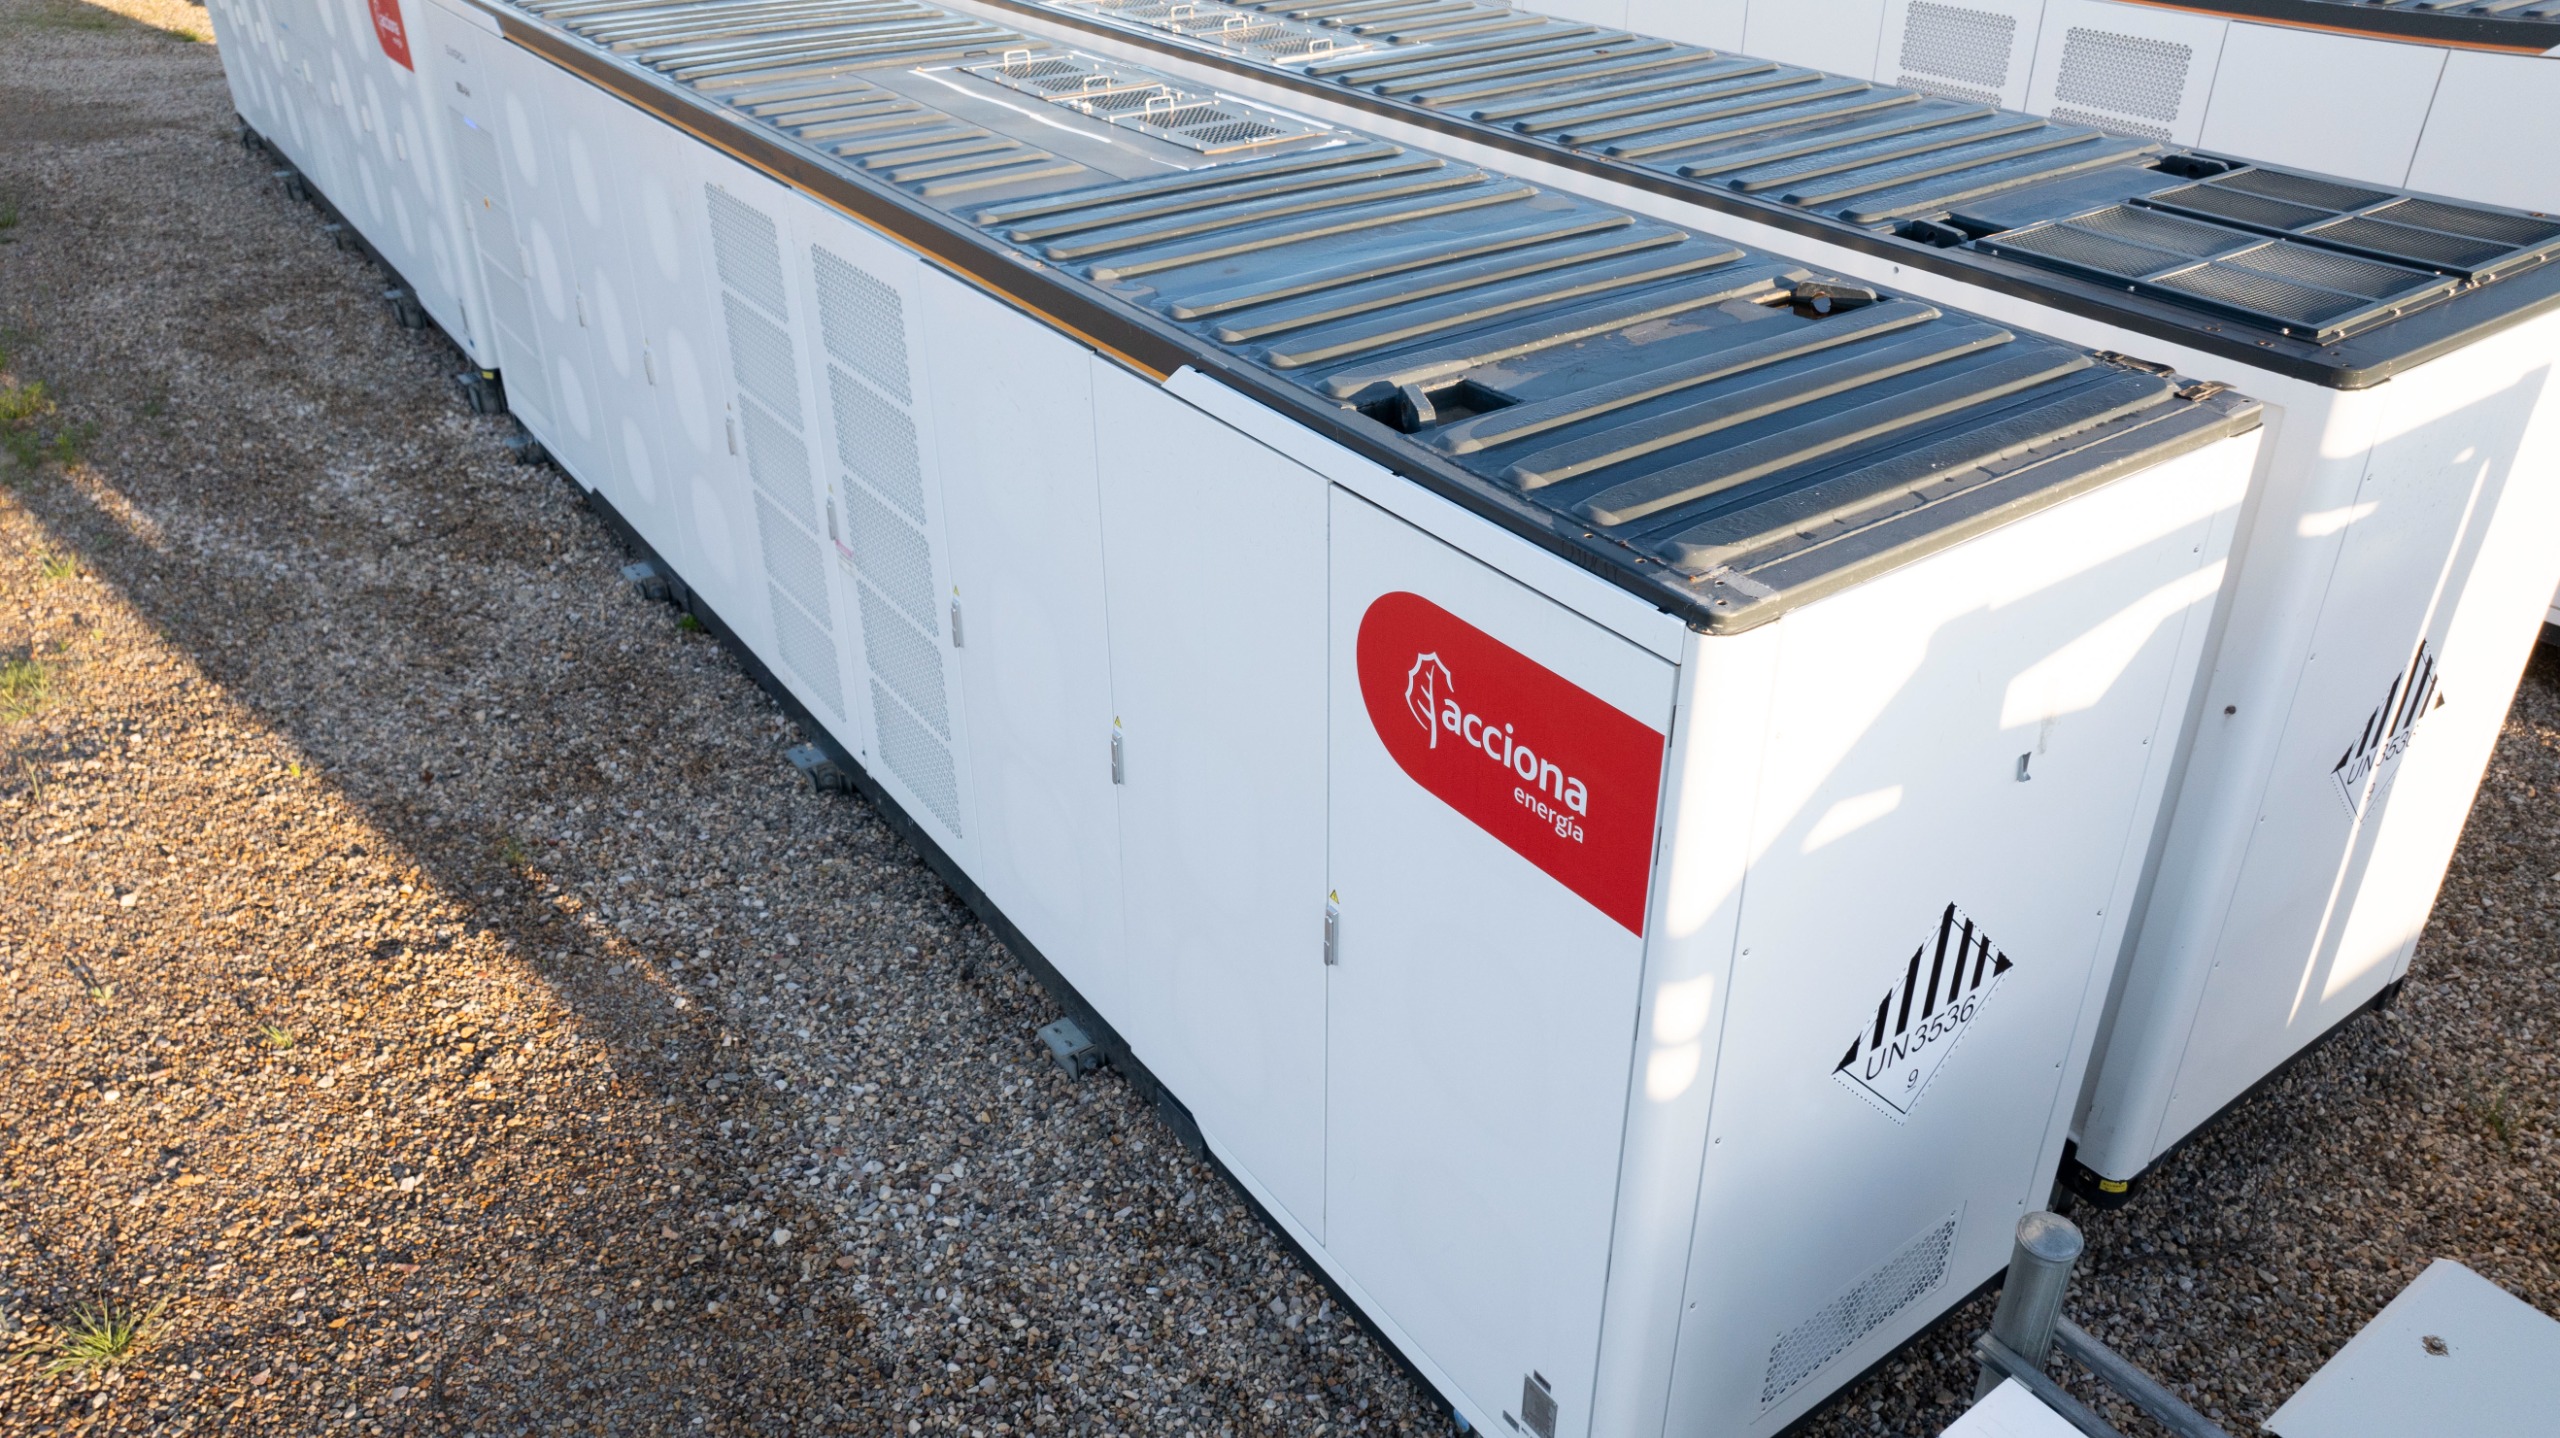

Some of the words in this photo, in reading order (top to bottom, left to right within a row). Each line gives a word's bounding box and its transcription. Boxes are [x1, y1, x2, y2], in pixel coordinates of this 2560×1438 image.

[1441, 699, 1588, 816] acciona
[1514, 787, 1584, 843] energía
[1907, 1068, 1919, 1089] 9
